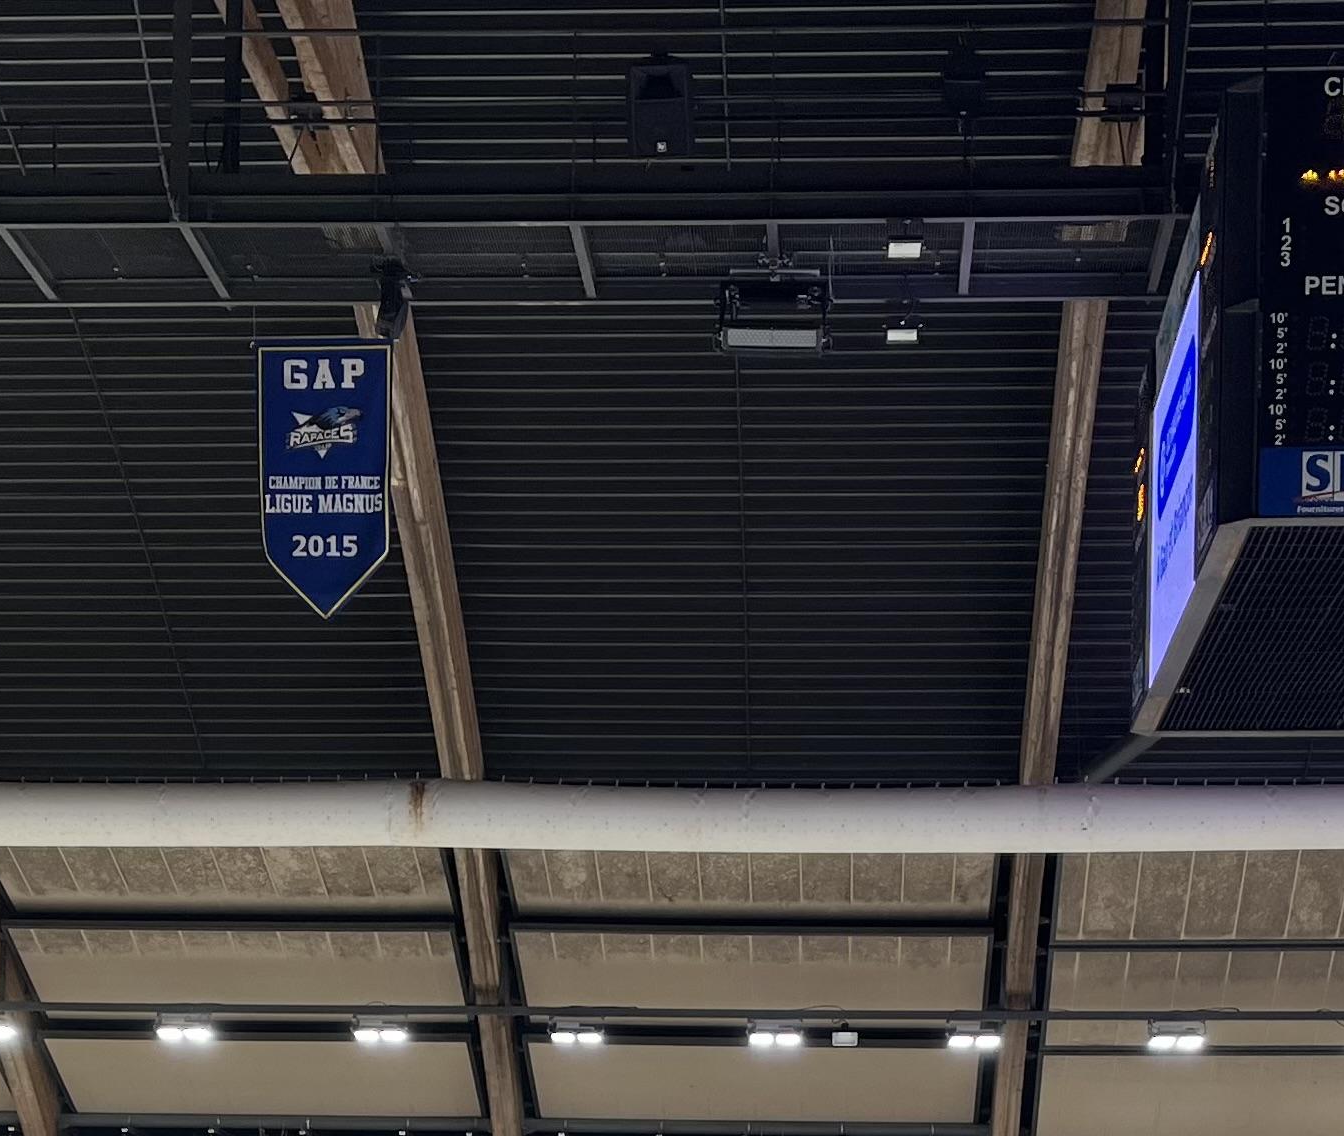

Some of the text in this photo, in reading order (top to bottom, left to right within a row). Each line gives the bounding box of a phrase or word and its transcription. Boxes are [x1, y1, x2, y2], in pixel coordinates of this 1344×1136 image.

[1282, 217, 1291, 233] 1
[1281, 235, 1292, 251] 2
[1280, 252, 1291, 267] 3
[283, 358, 365, 390] GAP
[290, 424, 353, 447] RAPACES
[269, 476, 380, 490] CHAMPION DE FRANCE
[265, 493, 382, 514] LIGUE MAGNUS
[292, 535, 358, 557] 2015
